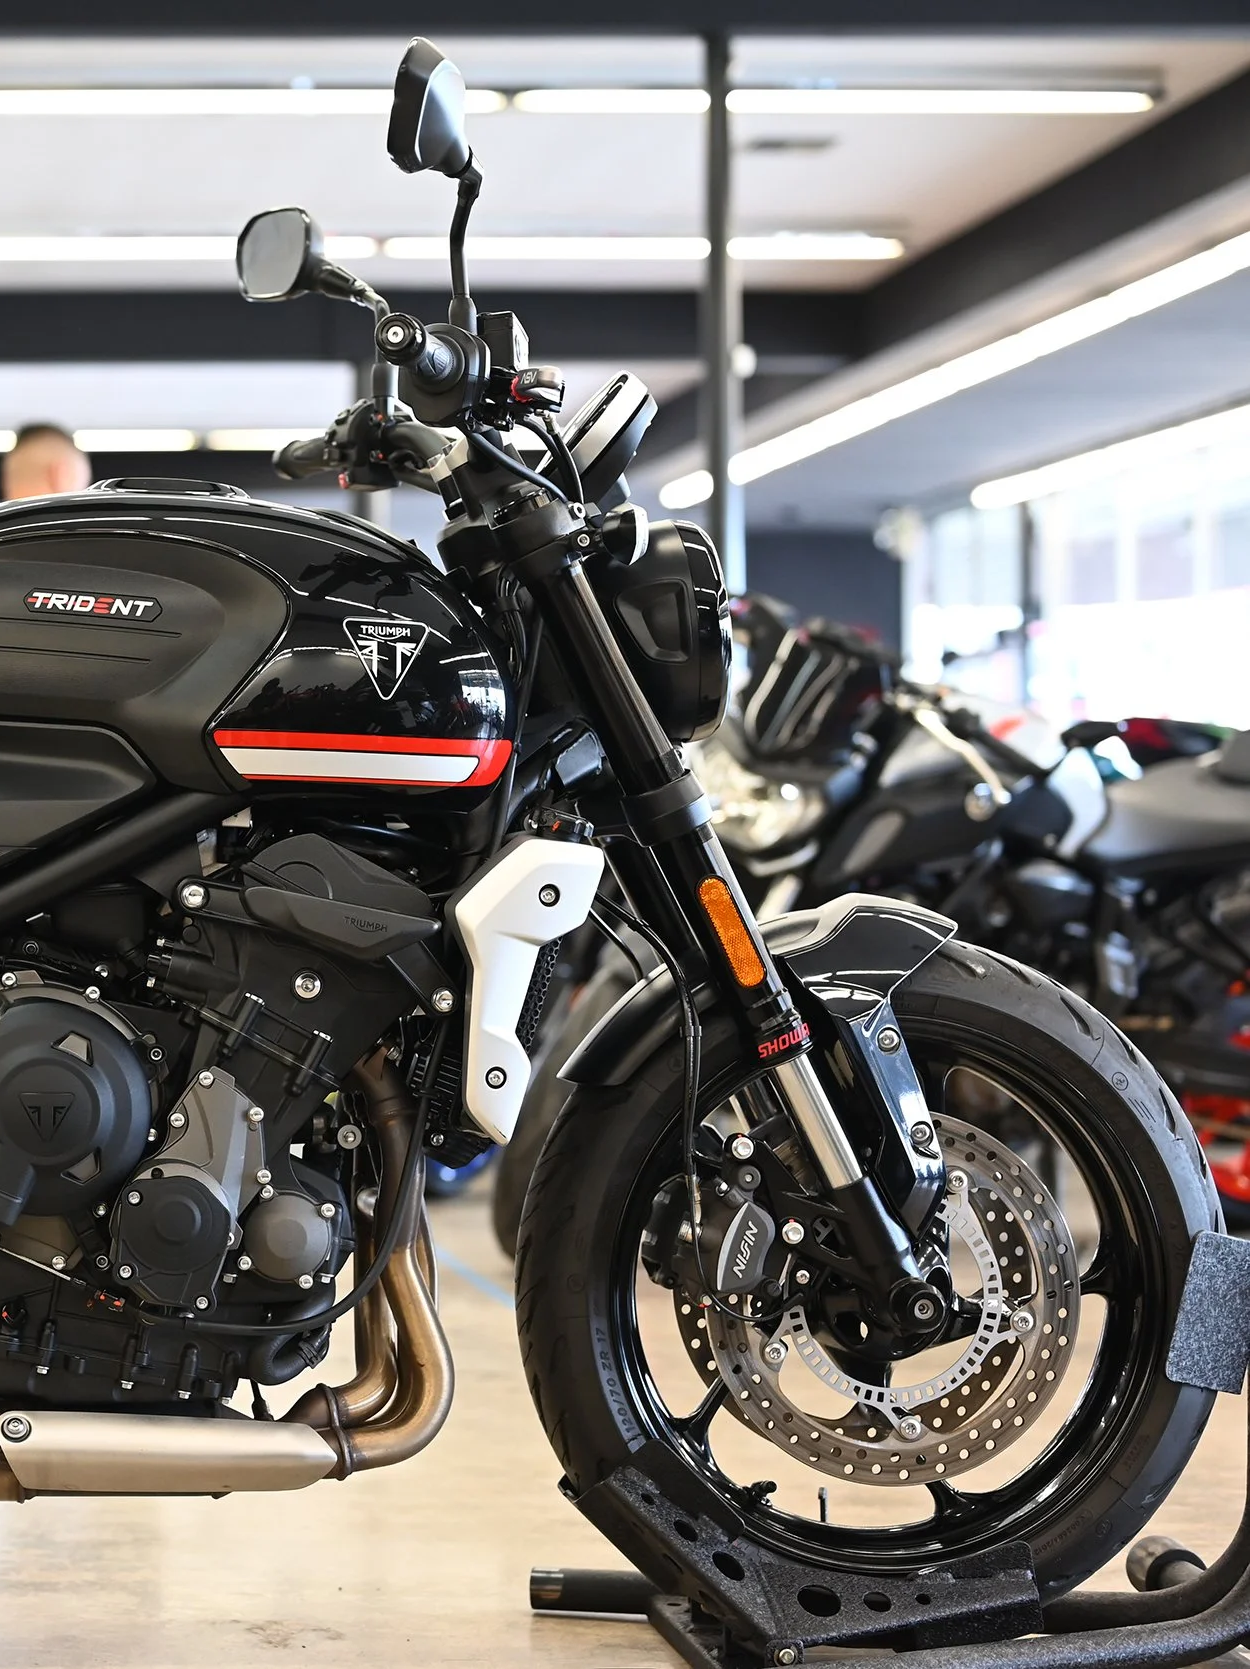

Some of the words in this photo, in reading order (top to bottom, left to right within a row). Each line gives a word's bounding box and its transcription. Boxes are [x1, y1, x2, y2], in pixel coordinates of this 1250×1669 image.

[28, 591, 154, 617] TRIDENT
[360, 624, 411, 640] TRIUMPH
[343, 916, 388, 933] TRIUMPH
[757, 1022, 811, 1059] SHOWA
[595, 1327, 607, 1344] 17
[598, 1351, 613, 1371] ZR
[605, 1377, 636, 1434] 120/70
